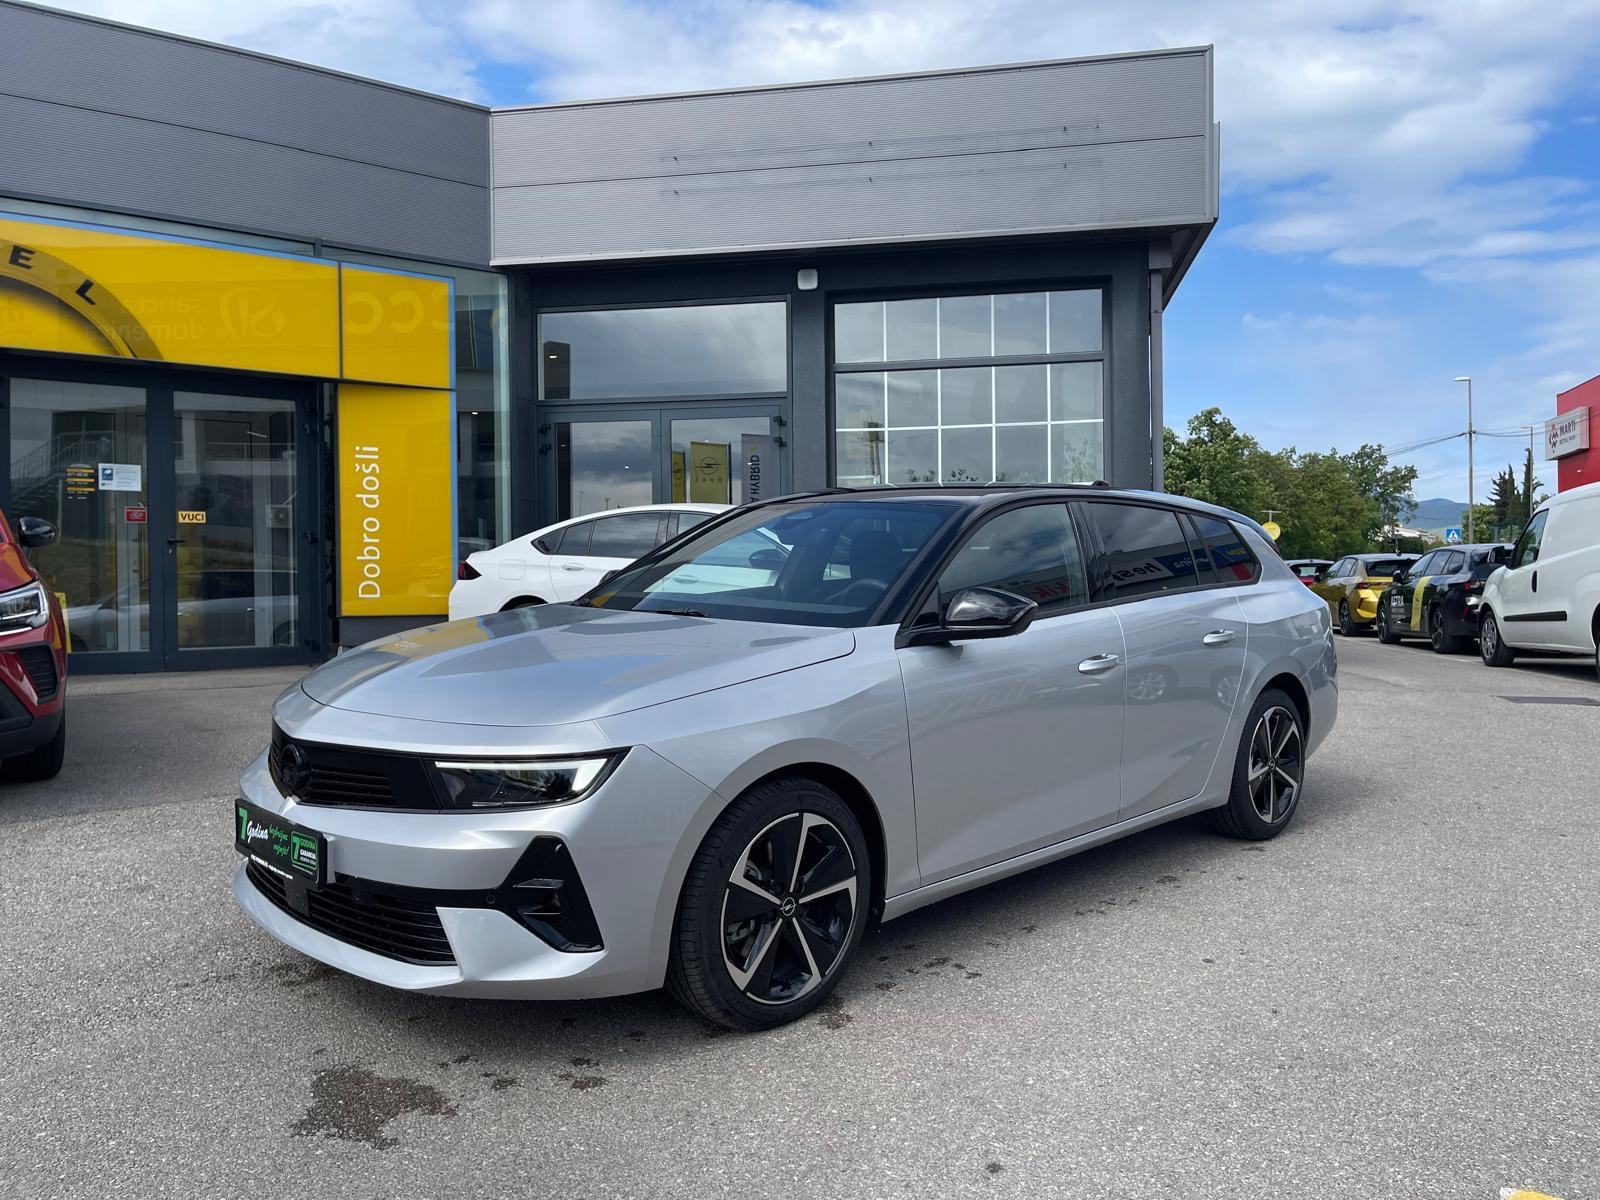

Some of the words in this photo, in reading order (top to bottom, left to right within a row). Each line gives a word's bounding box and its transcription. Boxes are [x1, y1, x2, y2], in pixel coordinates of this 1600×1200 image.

[355, 446, 381, 509] došli
[180, 513, 205, 522] VUCI
[356, 517, 381, 599] Dobro
[239, 807, 248, 840] 7
[247, 820, 269, 844] Godina
